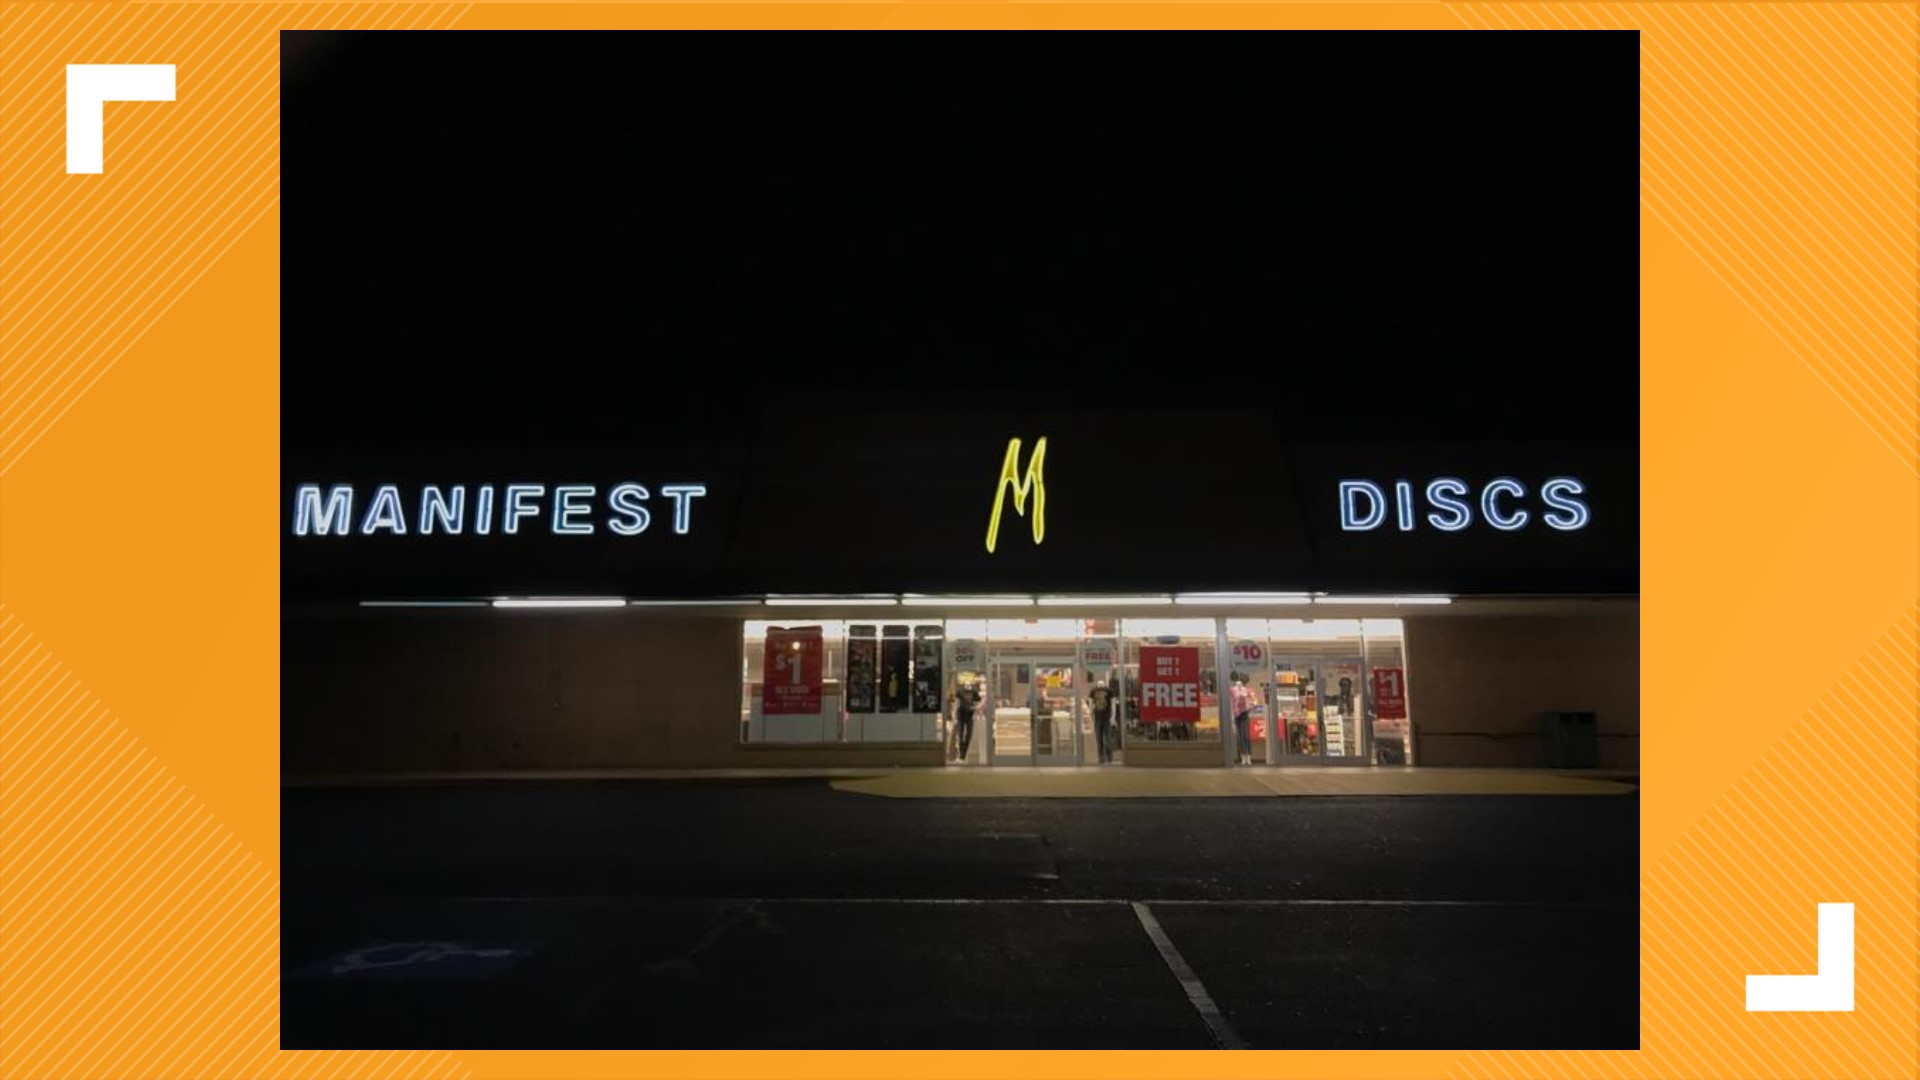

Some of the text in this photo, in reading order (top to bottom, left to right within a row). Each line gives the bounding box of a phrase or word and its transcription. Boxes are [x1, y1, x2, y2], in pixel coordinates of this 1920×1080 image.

[985, 436, 1046, 552] M
[1338, 477, 1590, 531] DISCS
[293, 483, 706, 535] MANIFEST
[955, 654, 975, 663] OFF
[1156, 656, 1173, 665] BUY
[1232, 644, 1261, 660] $10
[775, 653, 801, 684] $1
[1156, 667, 1173, 676] GET
[1142, 682, 1198, 708] FREE
[1378, 671, 1398, 697] $1
